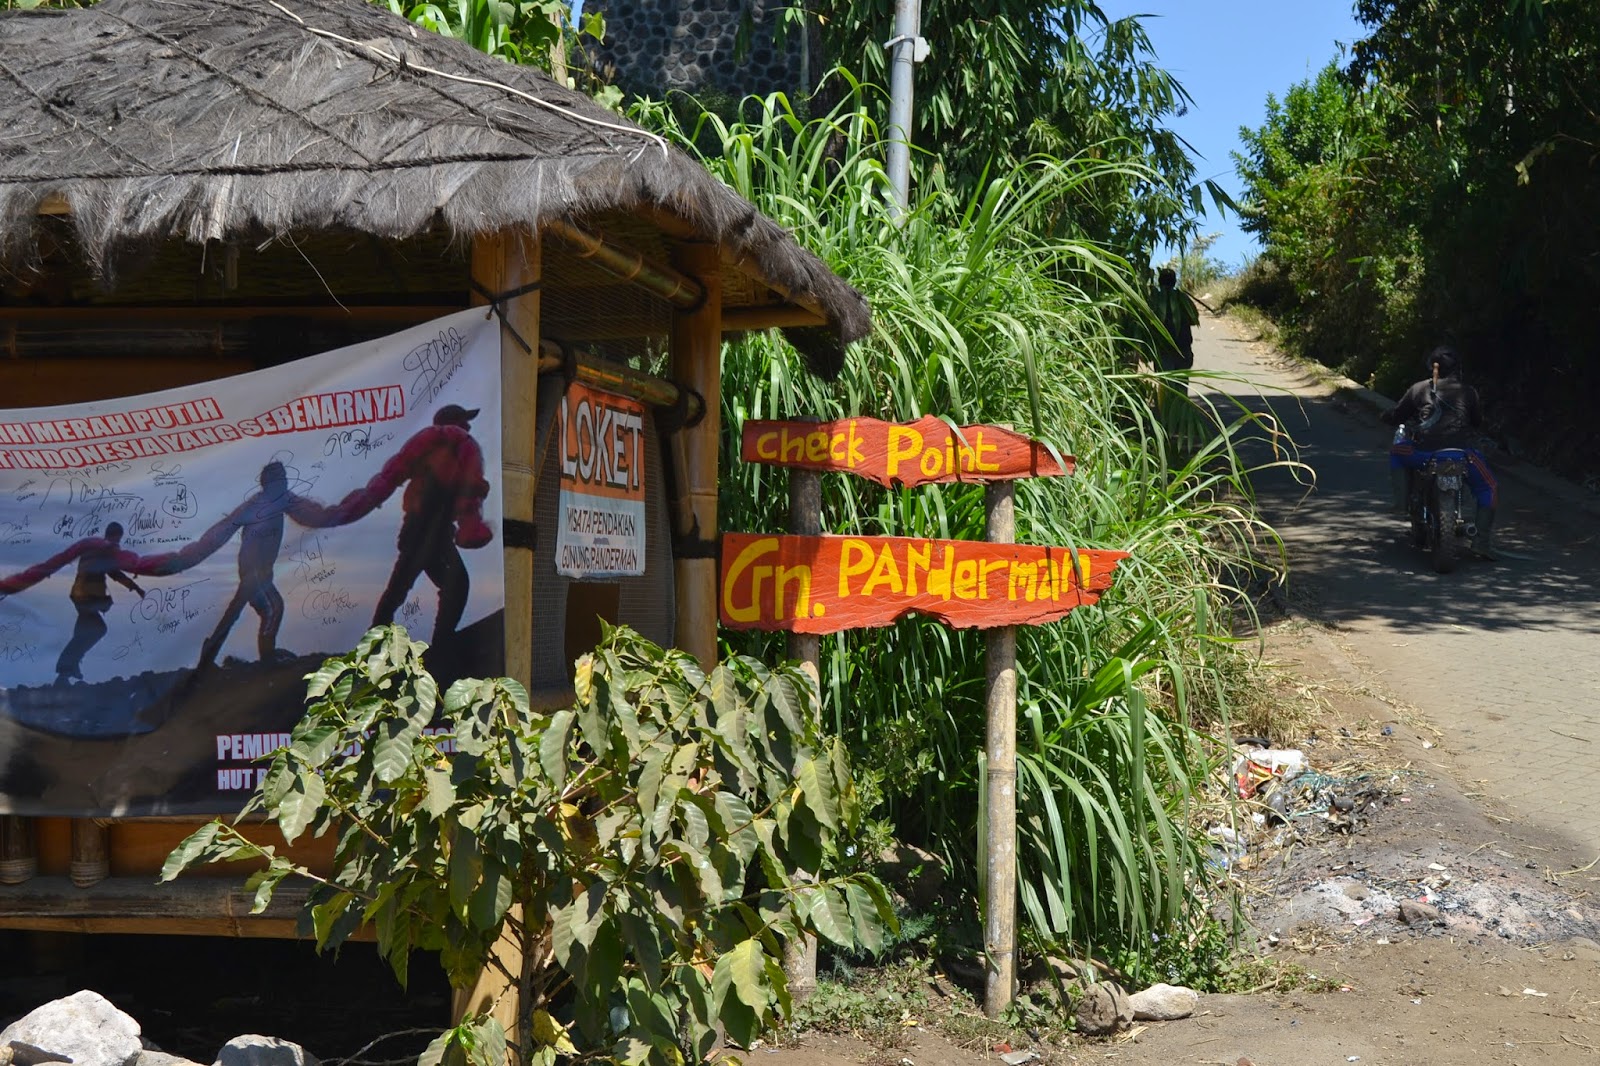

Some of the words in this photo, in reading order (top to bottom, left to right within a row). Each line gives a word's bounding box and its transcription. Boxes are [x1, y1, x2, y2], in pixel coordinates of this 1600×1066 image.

[10, 436, 168, 470] INDONESIA
[160, 423, 242, 453] YANG
[237, 384, 405, 438] SEBENARNYA
[27, 413, 135, 444] MERAH
[129, 398, 224, 432] PUTIH
[560, 395, 644, 491] LOKET
[886, 426, 1001, 477] Point
[592, 510, 636, 537] PENDAKIAN
[561, 545, 590, 570] GUNUNG
[590, 546, 638, 571] PANDERMAN
[723, 537, 826, 623] Gn.
[217, 768, 253, 790] HUT
